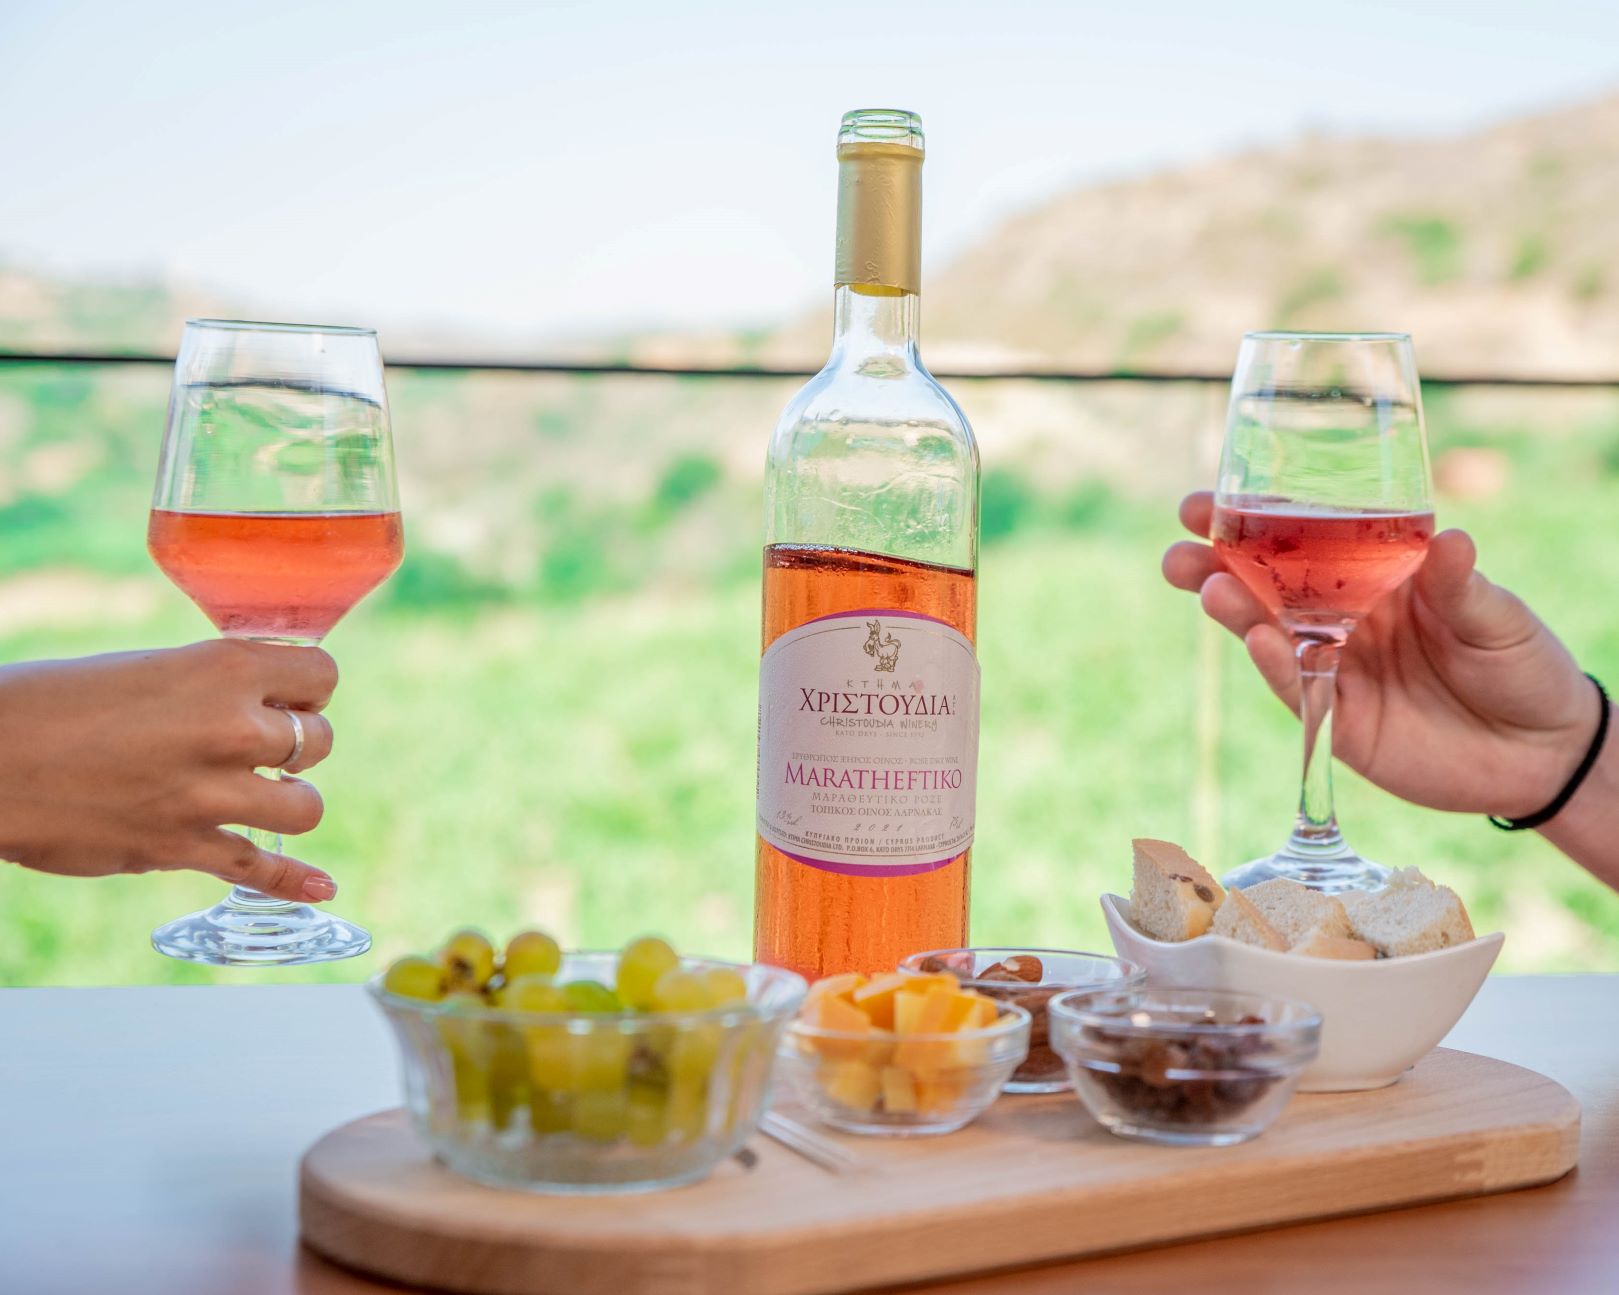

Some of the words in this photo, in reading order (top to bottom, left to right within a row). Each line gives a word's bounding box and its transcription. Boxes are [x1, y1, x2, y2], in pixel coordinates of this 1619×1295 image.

[799, 687, 951, 716] ΧΡΙΣΤΟΥΔΙΑ
[820, 716, 895, 729] CHRISTOUDIA
[784, 761, 962, 791] MARATHEFTIKO
[810, 803, 856, 817] ΤΟΠΙΚΟΣ
[857, 807, 892, 817] ΟΙΝΟΣ
